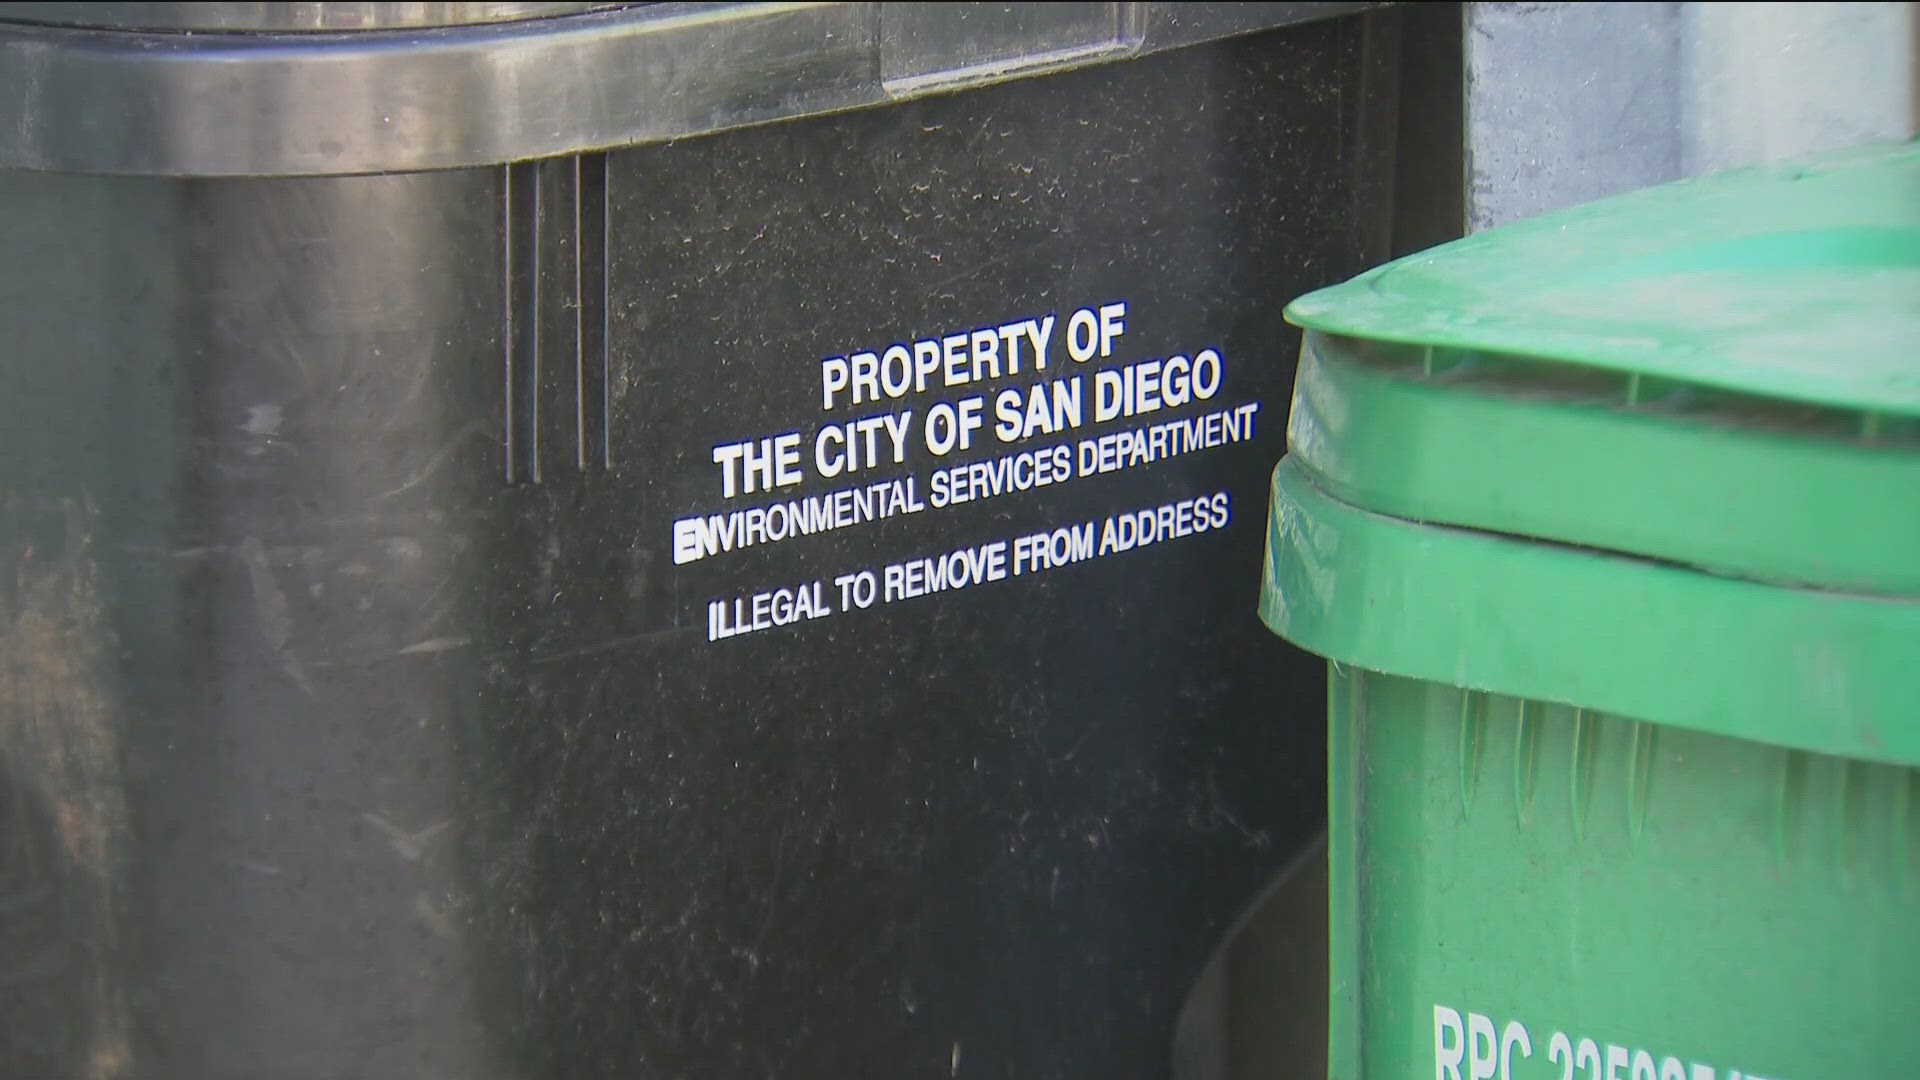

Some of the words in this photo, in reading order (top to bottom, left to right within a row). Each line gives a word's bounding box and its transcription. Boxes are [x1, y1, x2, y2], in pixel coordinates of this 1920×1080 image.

[712, 432, 803, 499] THE
[815, 410, 912, 478] CITY
[924, 396, 984, 456] OF
[995, 376, 1082, 442] SAN
[1094, 349, 1221, 423] DIEGO
[822, 315, 1055, 411] PROPERTY
[1066, 302, 1126, 363] OF
[673, 476, 925, 565] ENVIRONMENTAL
[930, 445, 1071, 508] SERVICES
[1078, 402, 1258, 478] DEPARTMENT
[708, 580, 831, 642] ILLEGAL
[834, 570, 876, 612] TO
[884, 541, 1007, 603] REMOVE
[1013, 521, 1094, 576] FROM
[1098, 492, 1228, 556] ADDRESS
